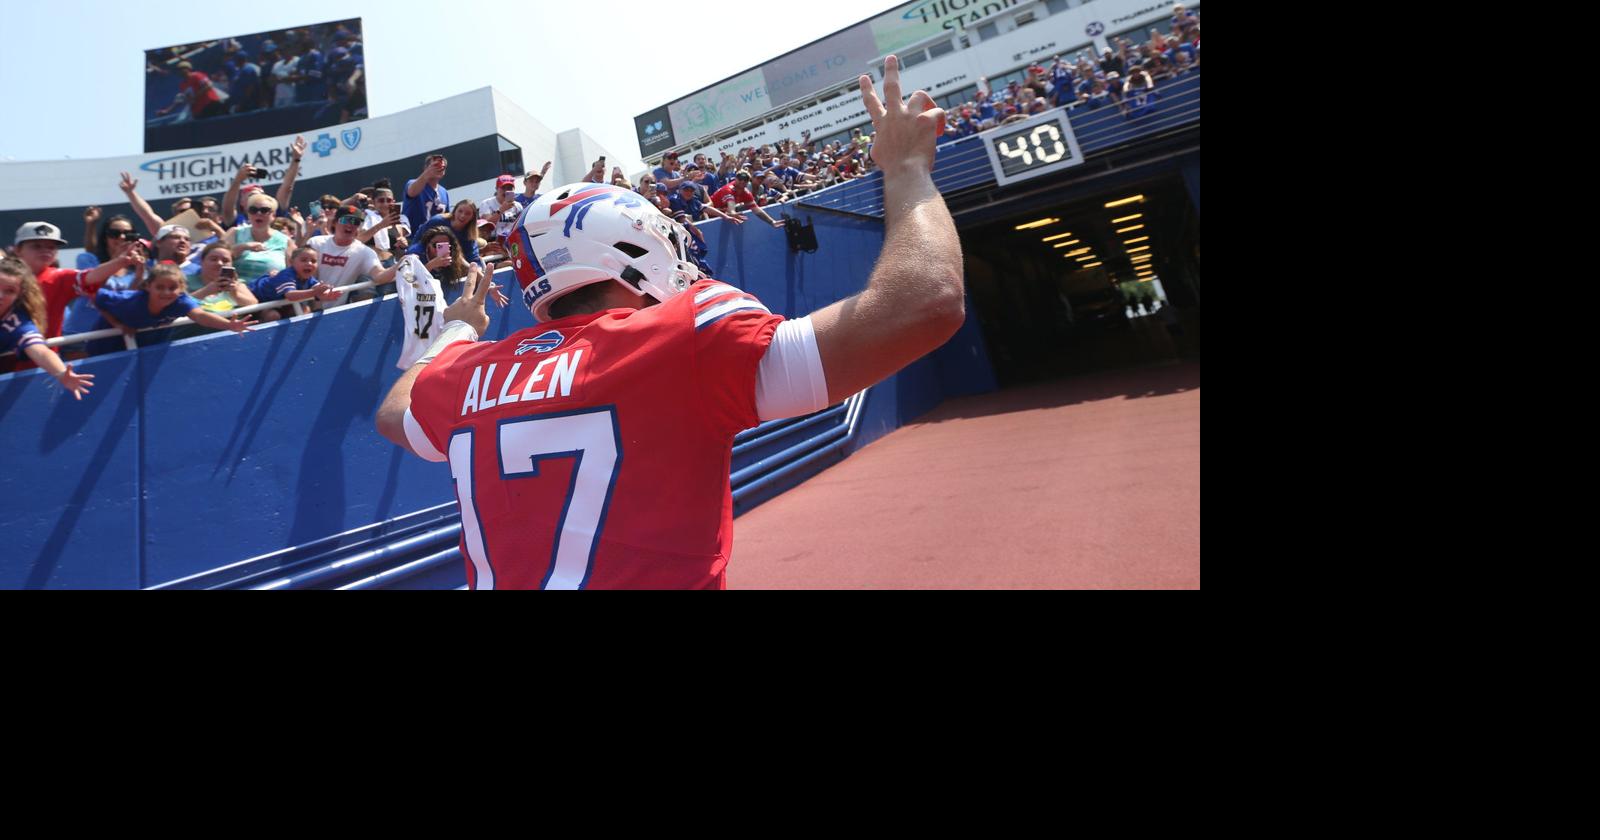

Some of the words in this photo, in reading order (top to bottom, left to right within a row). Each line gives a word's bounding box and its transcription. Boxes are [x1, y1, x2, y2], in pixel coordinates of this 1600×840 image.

[919, 0, 977, 23] HIG
[741, 64, 817, 104] WELCOME
[824, 54, 847, 69] TO
[779, 121, 789, 130] 34
[791, 109, 823, 124] COOKIE
[814, 123, 832, 132] PHIL
[835, 109, 869, 124] HANSE
[719, 142, 735, 151] LOU
[999, 124, 1065, 166] 40
[159, 178, 225, 195] WESTERN
[267, 166, 303, 182] YO
[413, 304, 435, 339] 17
[461, 350, 583, 416] ALLEN
[447, 404, 624, 590] 17
